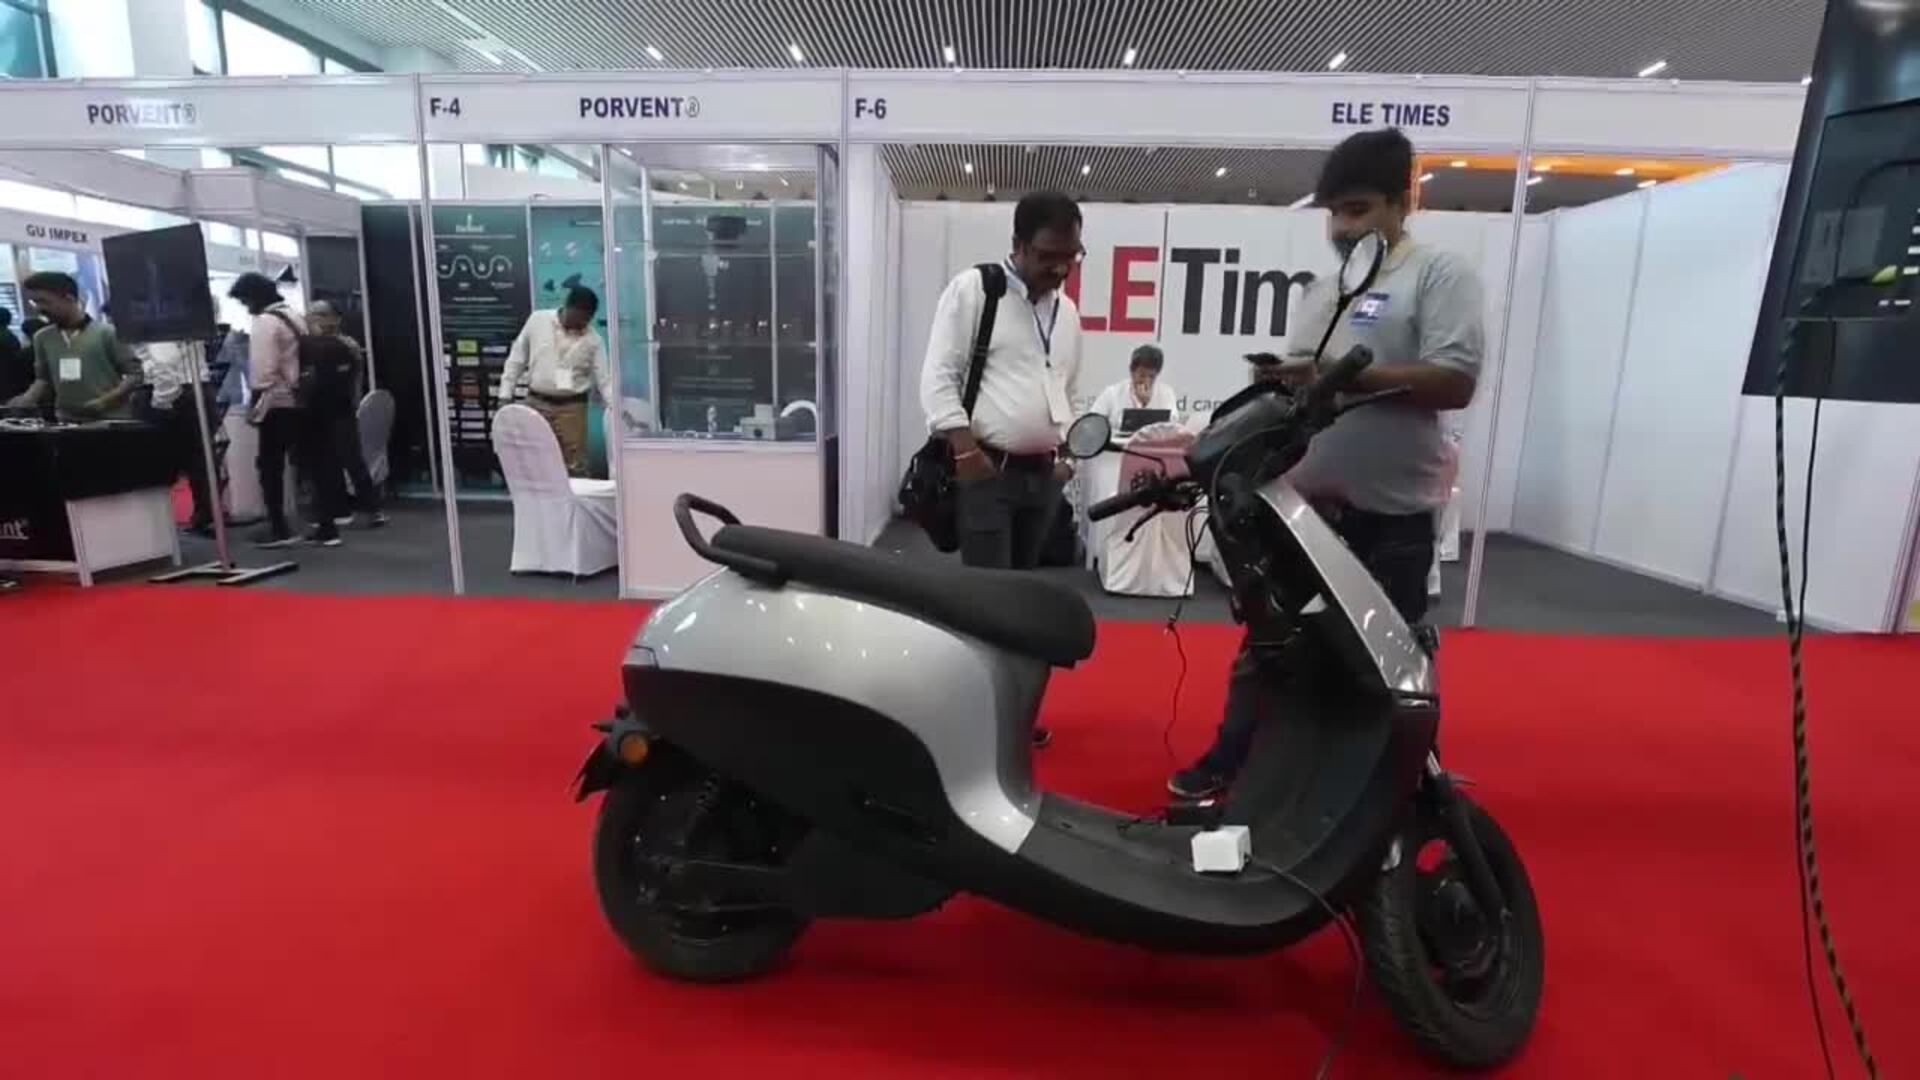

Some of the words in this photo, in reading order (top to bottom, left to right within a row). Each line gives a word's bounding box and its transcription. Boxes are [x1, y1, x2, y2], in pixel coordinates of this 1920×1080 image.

[430, 97, 461, 117] F-4
[855, 97, 887, 120] F-6
[1331, 102, 1374, 125] ELE
[1380, 103, 1450, 127] TIMES
[1064, 245, 1160, 333] LE
[1170, 247, 1316, 337] Tim
